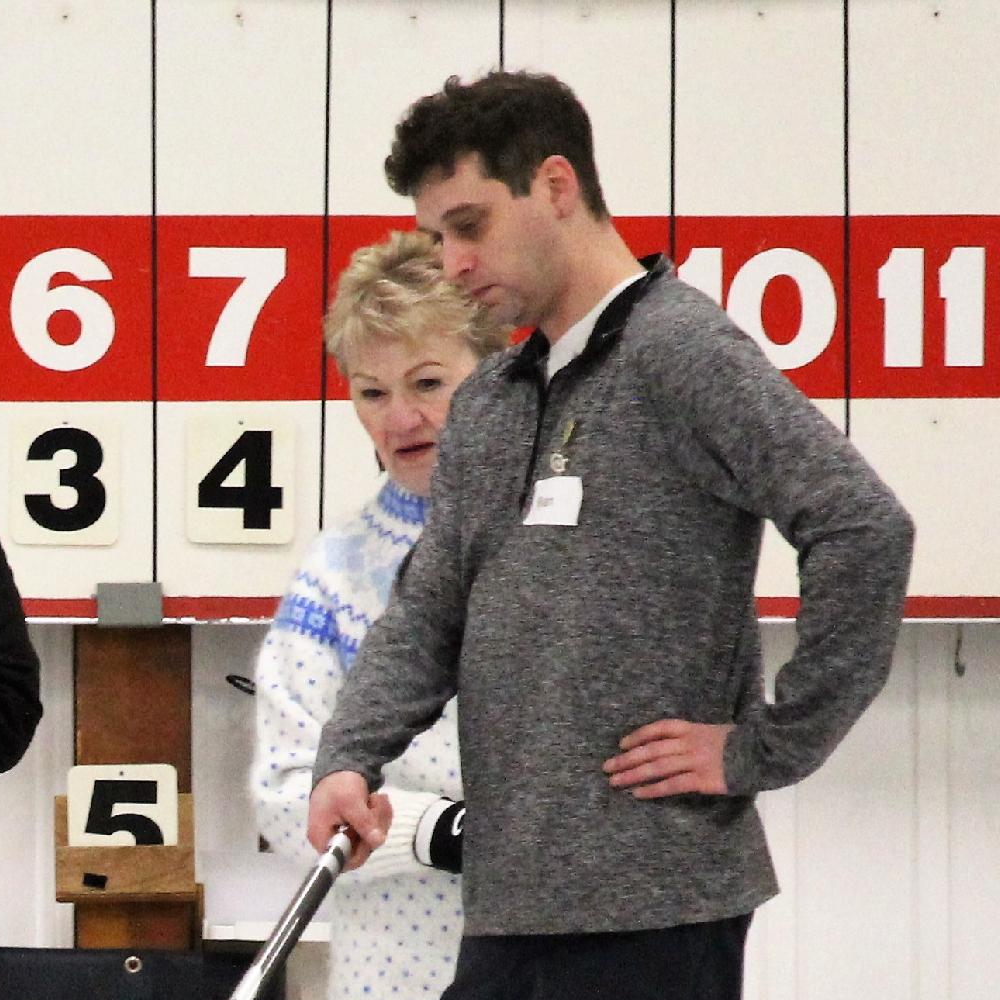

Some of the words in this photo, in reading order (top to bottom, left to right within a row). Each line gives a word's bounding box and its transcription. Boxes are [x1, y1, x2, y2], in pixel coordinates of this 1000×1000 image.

[10, 247, 115, 372] 6
[188, 247, 287, 367] 7
[877, 247, 986, 368] 11
[24, 427, 106, 532] 3
[198, 430, 283, 530] 4
[85, 779, 164, 846] 5
